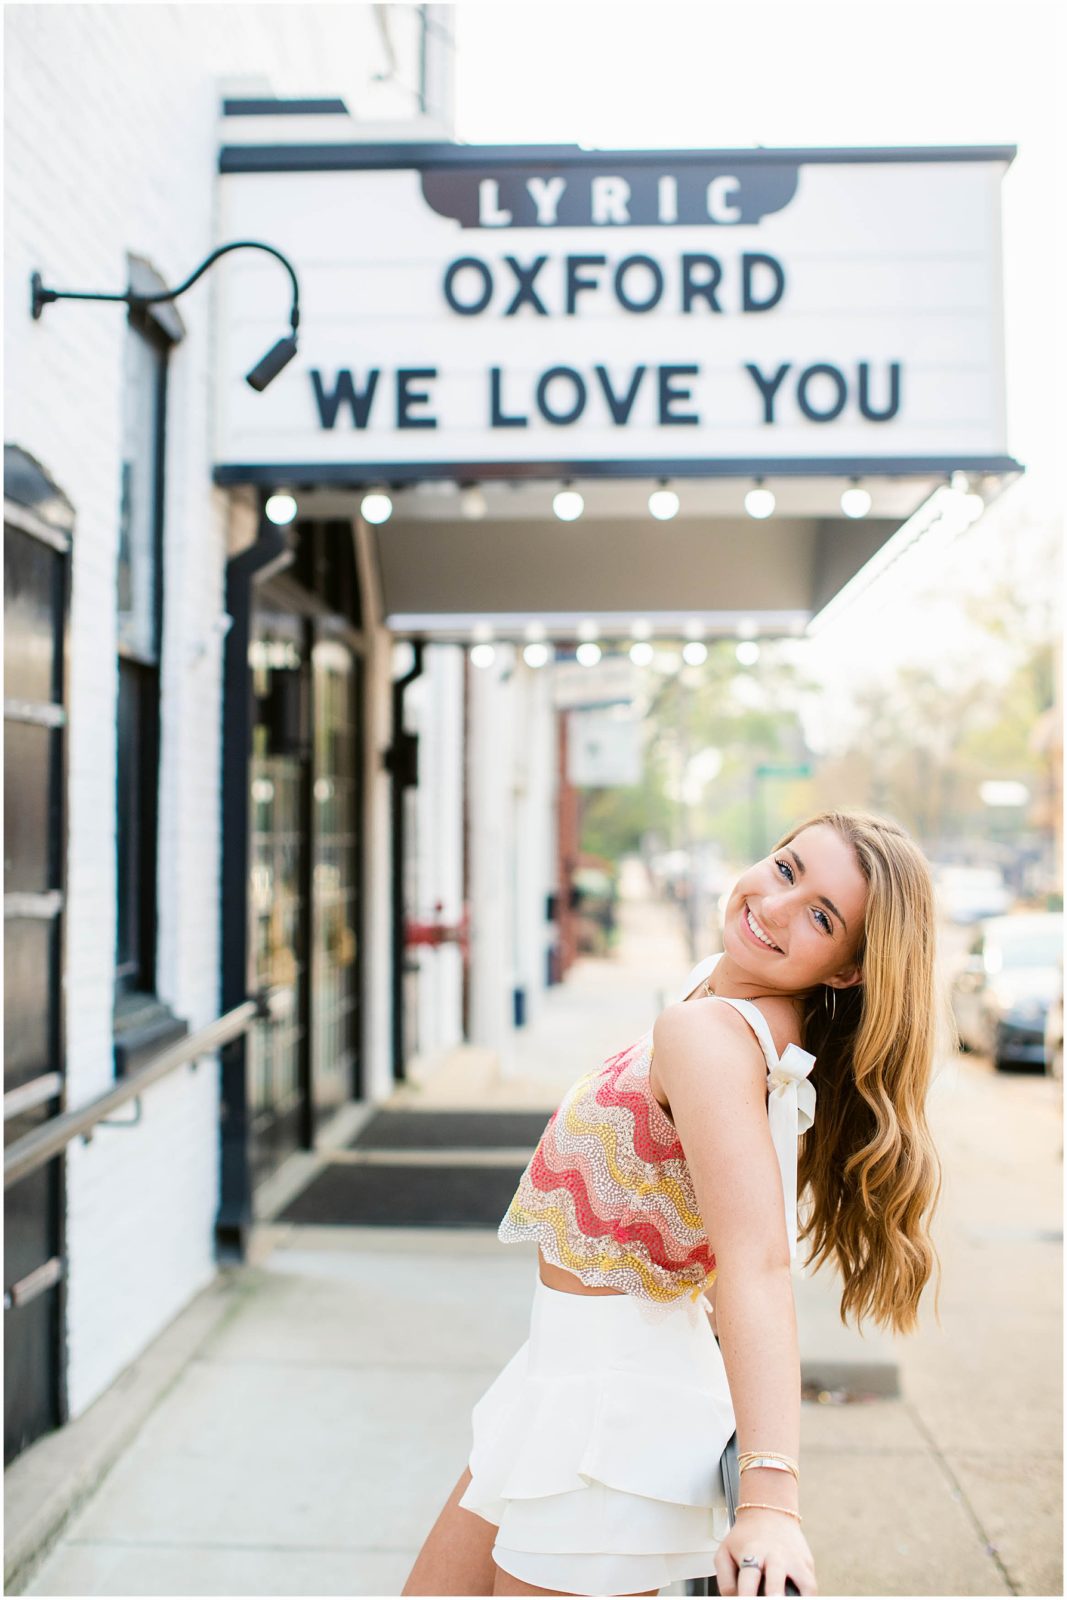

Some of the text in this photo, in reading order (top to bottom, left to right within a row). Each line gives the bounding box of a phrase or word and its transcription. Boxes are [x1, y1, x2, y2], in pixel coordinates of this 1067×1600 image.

[478, 174, 743, 227] LYRIC
[441, 252, 787, 317] OXFORD
[307, 361, 903, 432] WE LOVE YOU
